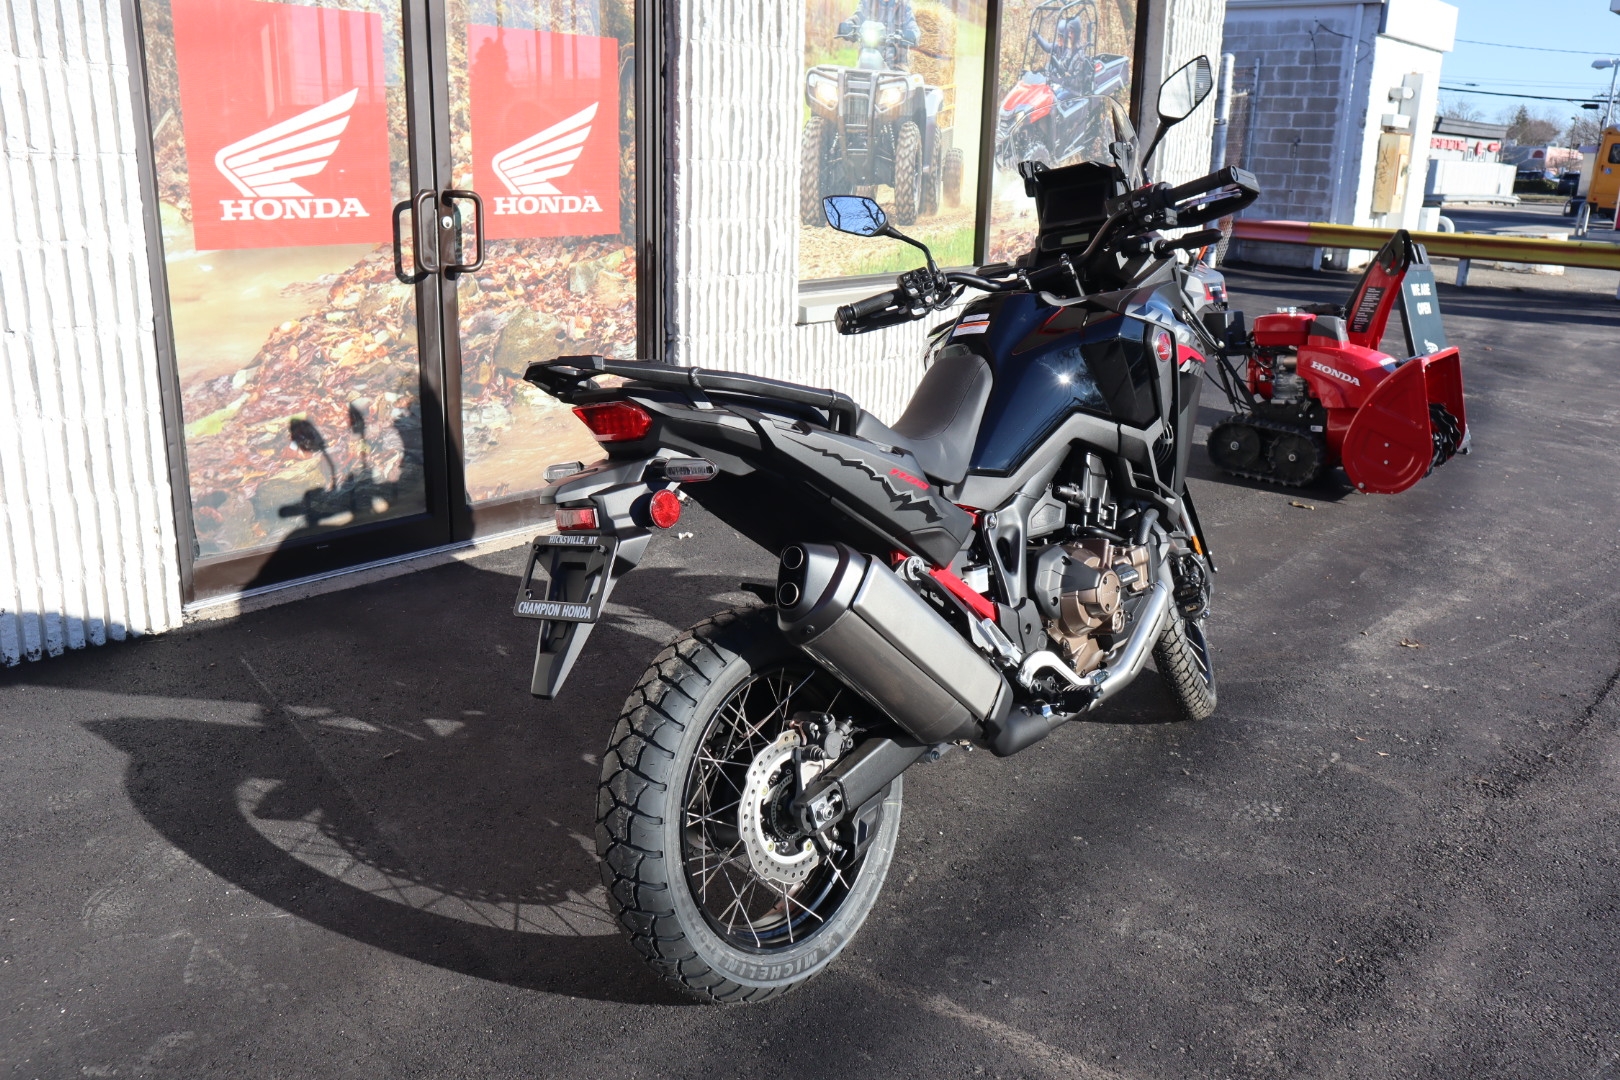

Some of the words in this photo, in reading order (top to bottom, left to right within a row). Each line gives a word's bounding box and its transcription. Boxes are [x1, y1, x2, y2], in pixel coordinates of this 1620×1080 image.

[219, 197, 370, 221] HONDA
[493, 195, 604, 215] HONDA
[1310, 361, 1361, 387] HONDA
[548, 535, 586, 545] HICKSVILLE,
[587, 535, 598, 545] NY
[518, 602, 561, 617] CHAMPION
[562, 605, 591, 619] HONDA
[724, 952, 818, 980] MICHELIN
